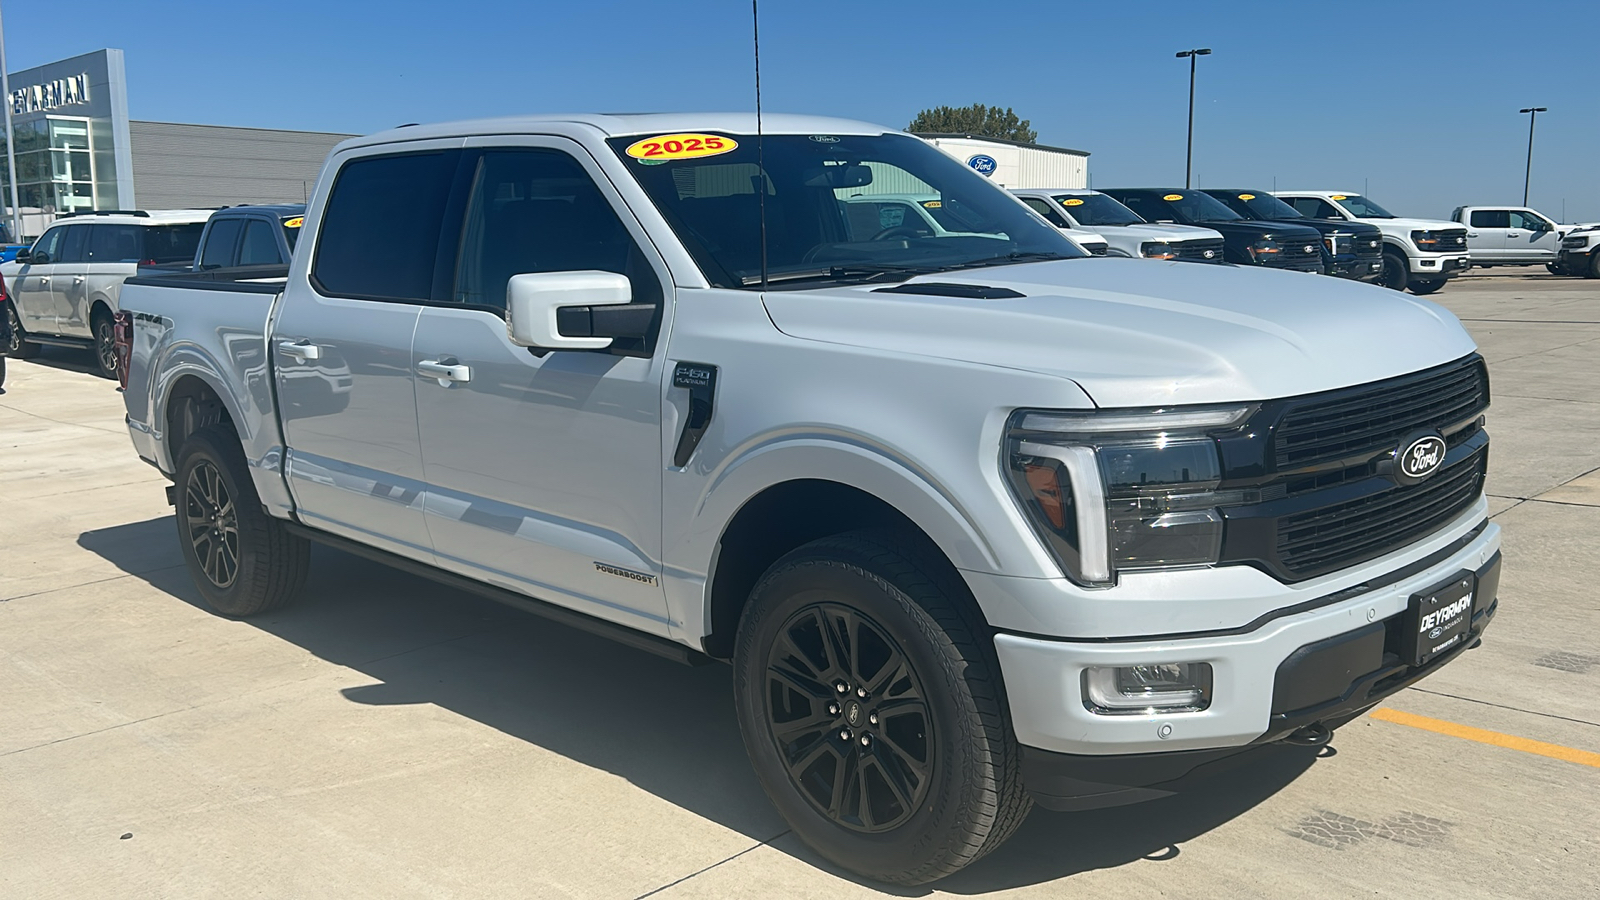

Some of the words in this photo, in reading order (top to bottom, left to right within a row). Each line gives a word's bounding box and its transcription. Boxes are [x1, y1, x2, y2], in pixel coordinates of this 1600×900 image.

[8, 73, 89, 114] EYARMAN
[642, 138, 723, 156] 2025
[974, 158, 993, 170] Ford
[676, 367, 710, 379] F-150
[676, 378, 709, 386] PLATINUM
[1410, 441, 1439, 472] Ford
[595, 564, 653, 584] POWERBOOST
[1420, 592, 1472, 633] DEYARMAN
